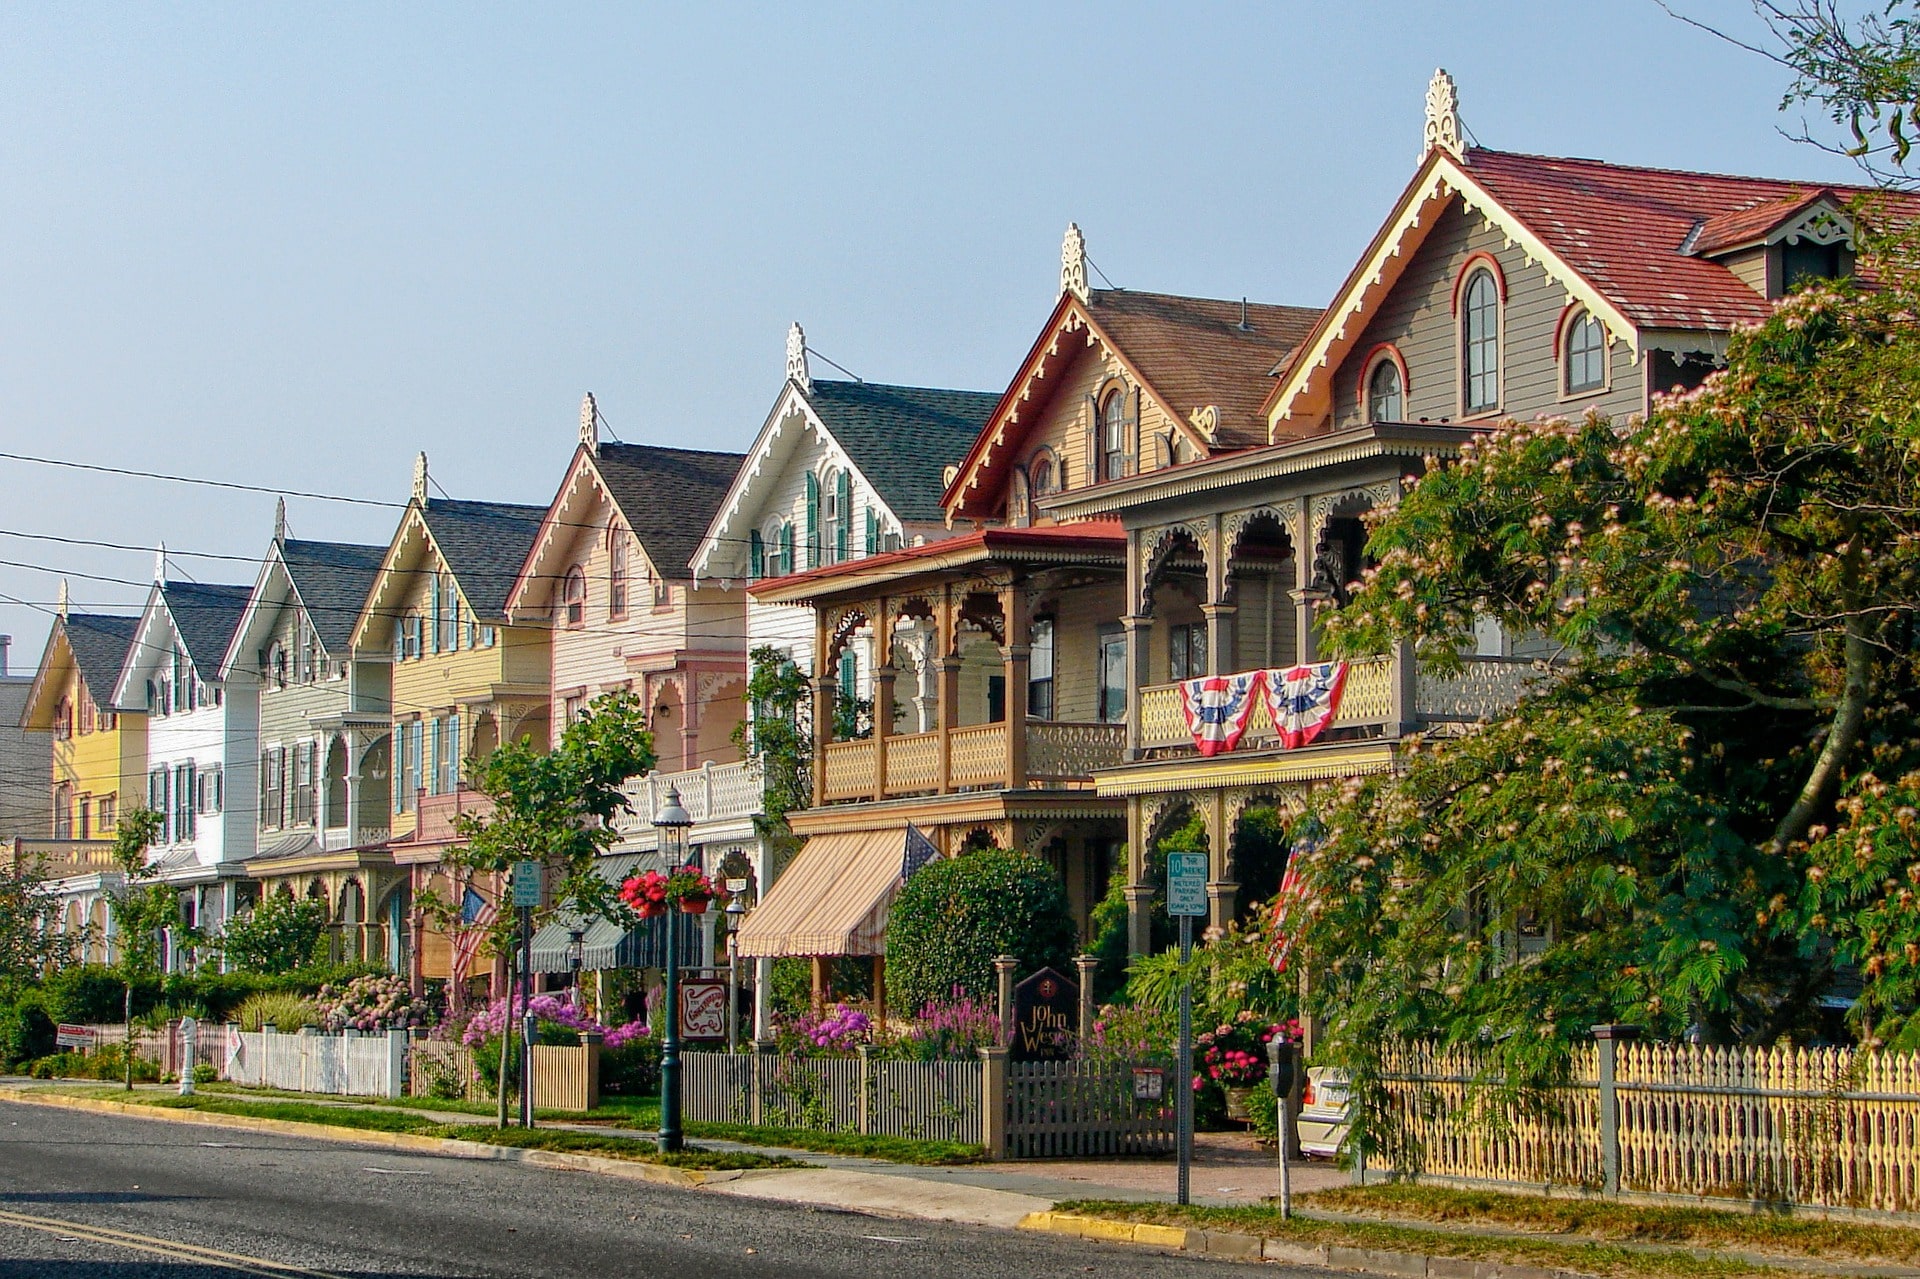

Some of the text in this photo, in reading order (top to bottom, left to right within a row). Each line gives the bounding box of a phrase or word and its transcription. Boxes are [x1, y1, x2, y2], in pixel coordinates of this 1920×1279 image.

[523, 865, 533, 875] 15
[1171, 860, 1181, 873] 10
[1026, 1005, 1067, 1033] John
